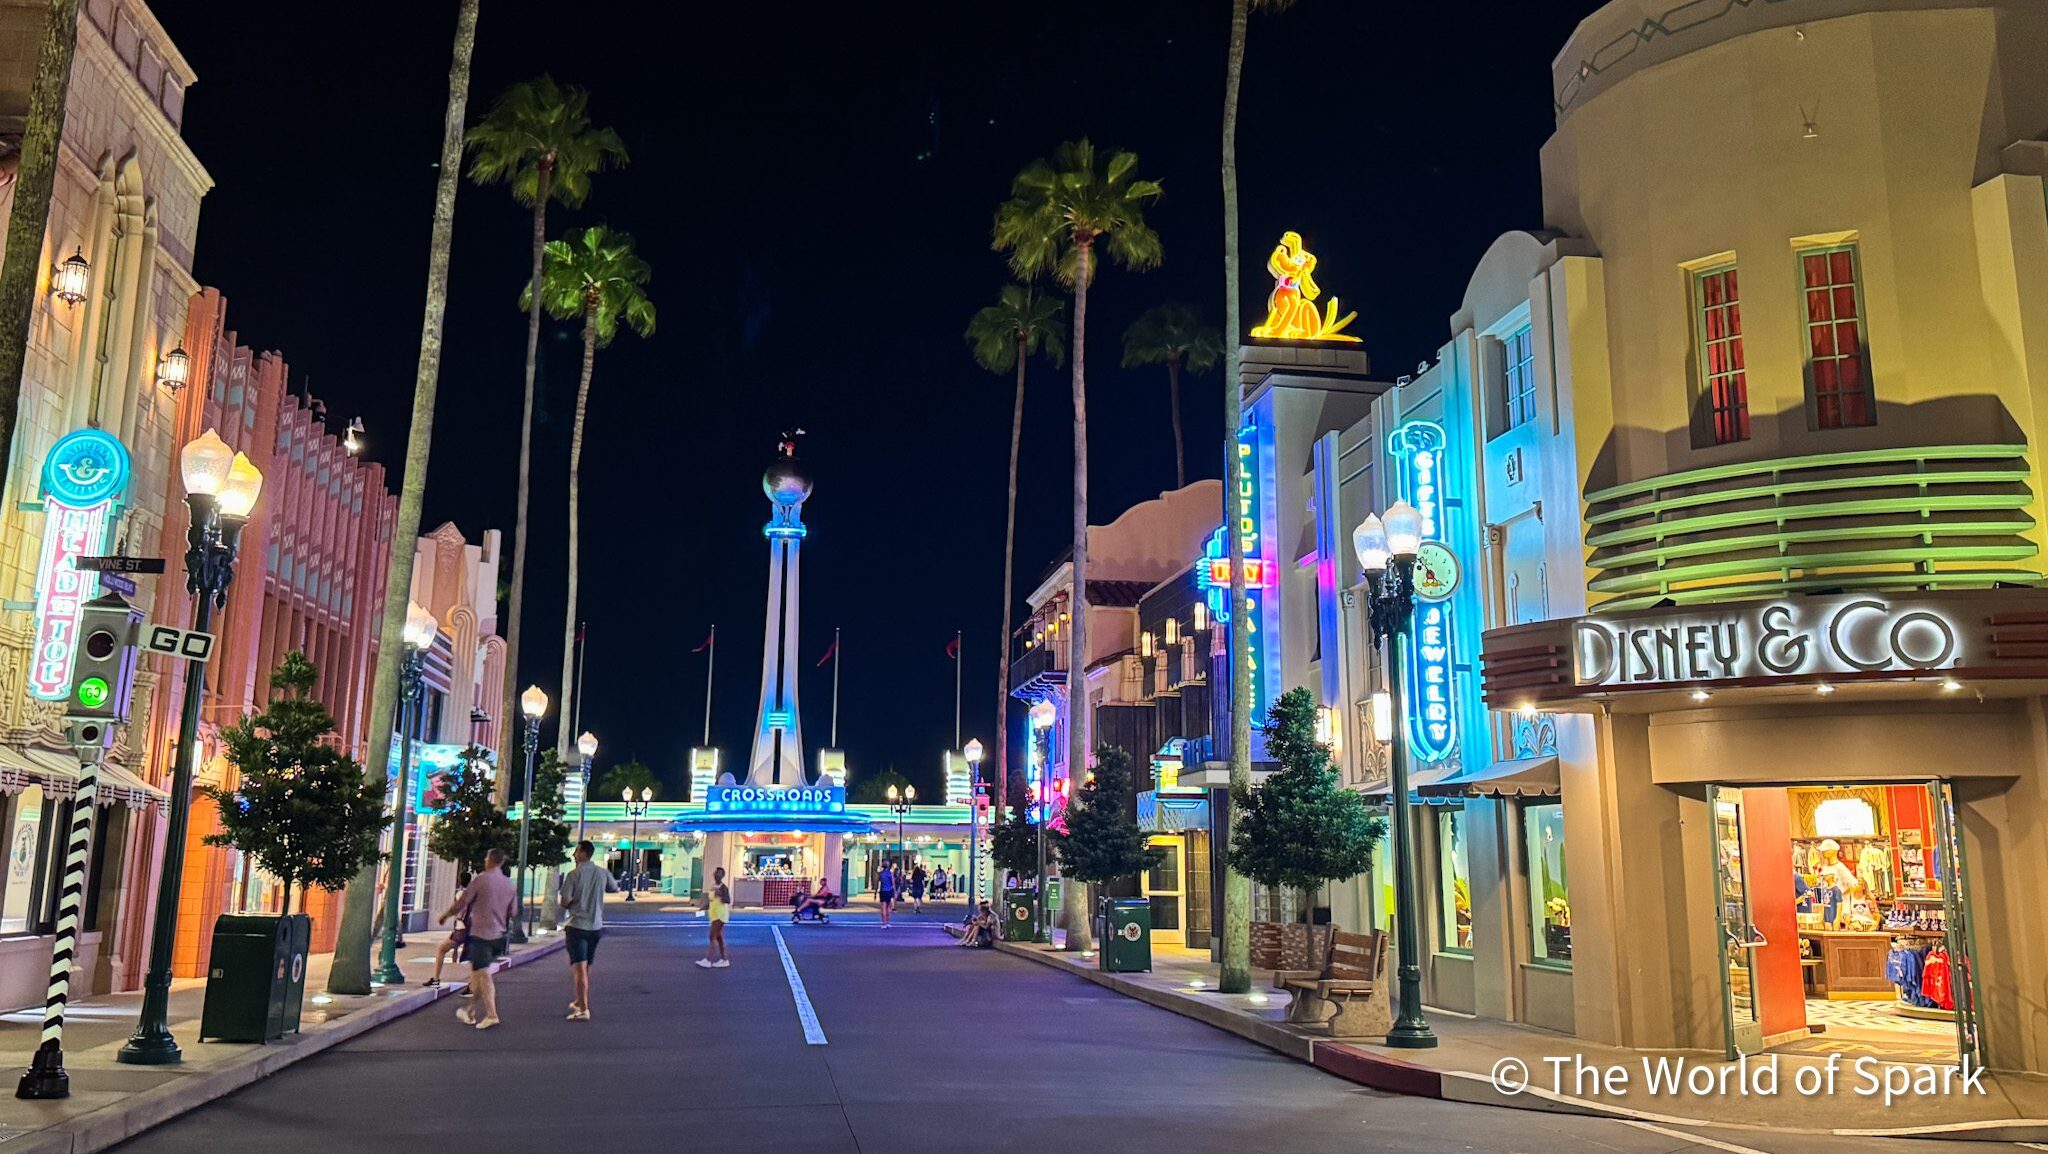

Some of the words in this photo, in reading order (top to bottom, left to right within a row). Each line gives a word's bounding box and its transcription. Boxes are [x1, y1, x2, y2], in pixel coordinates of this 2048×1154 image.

[1415, 451, 1436, 536] GIFTS
[98, 558, 123, 570] VINE
[125, 560, 142, 571] ST.
[149, 626, 212, 659] GO
[1573, 620, 1741, 687] DISNEY
[1757, 604, 1809, 674] &
[1828, 599, 1963, 672] CO.
[1421, 607, 1448, 740] JEWELRY
[721, 788, 832, 803] CROSSROADS
